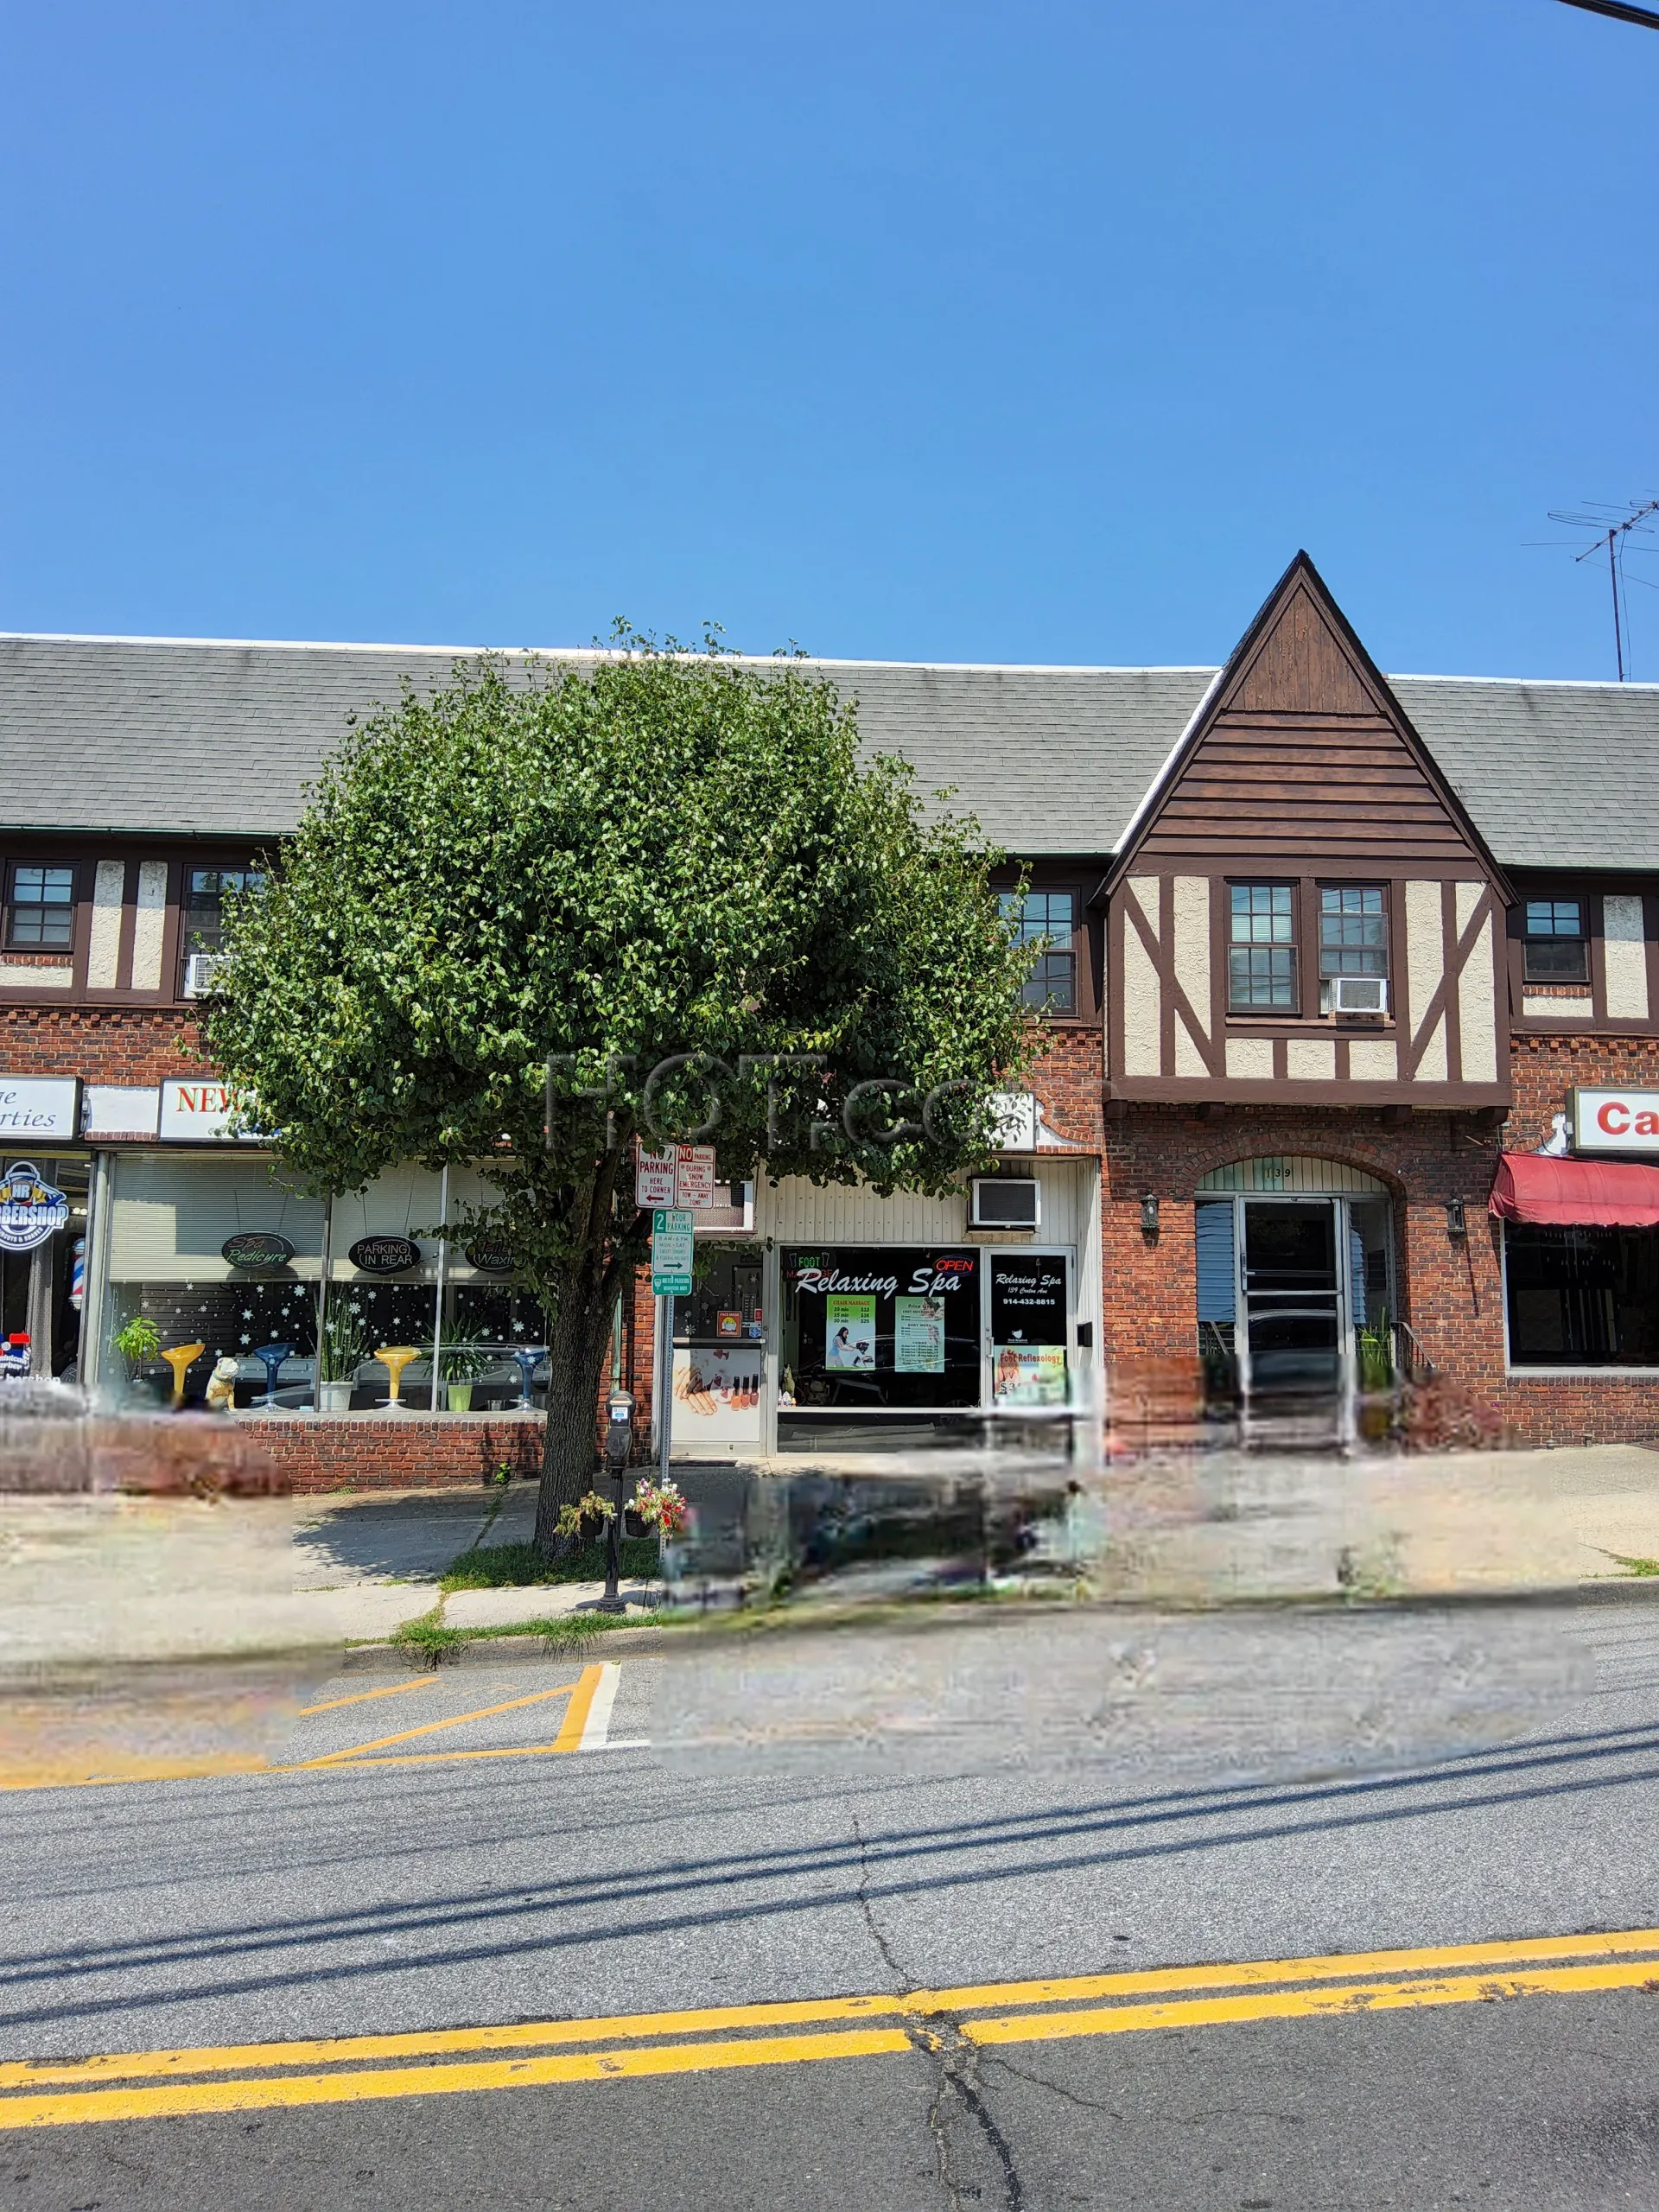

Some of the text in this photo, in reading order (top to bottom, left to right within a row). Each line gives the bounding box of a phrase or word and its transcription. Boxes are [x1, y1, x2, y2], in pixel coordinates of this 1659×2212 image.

[1597, 1102, 1659, 1135] Ca
[679, 1147, 692, 1160] NO
[639, 1161, 673, 1175] PARKING
[1267, 1168, 1291, 1178] 139
[12, 1184, 30, 1198] HR
[650, 1185, 671, 1194] CORNER
[656, 1212, 686, 1230] 2 HOUR
[667, 1223, 690, 1232] PARKING
[227, 1236, 265, 1251] Spa
[357, 1244, 408, 1255] PARKING
[226, 1249, 287, 1262] Pedicure
[365, 1255, 413, 1265] IN REAR
[798, 1256, 821, 1268] FOOT
[935, 1260, 974, 1272] OPEN
[795, 1268, 961, 1300] Relaxing Spa
[995, 1273, 1062, 1287] Relaxing Spa
[1000, 1353, 1060, 1364] Foot Reflexology
